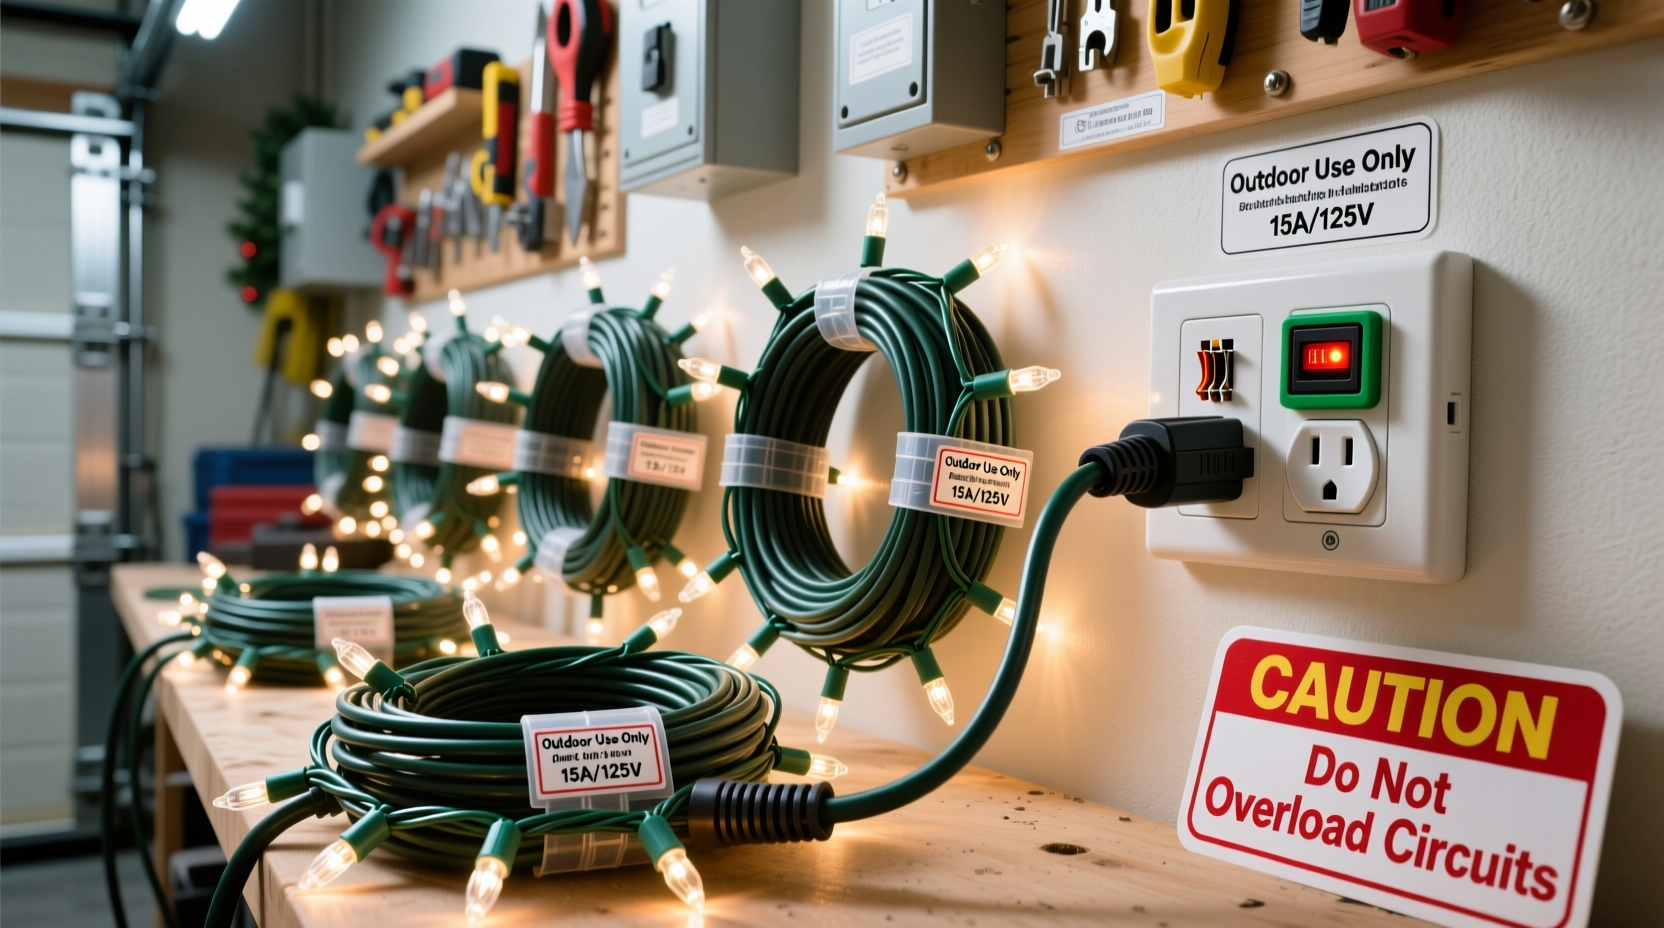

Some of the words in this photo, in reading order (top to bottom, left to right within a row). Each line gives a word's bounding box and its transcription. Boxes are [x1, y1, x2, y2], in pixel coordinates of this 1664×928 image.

[1230, 165, 1310, 194] Outdoor
[1315, 157, 1356, 180] Use
[1361, 143, 1416, 173] Only
[1269, 202, 1375, 237] 15A/125V
[952, 485, 1010, 506] 15A/125V
[1249, 653, 1559, 761] CAUTION
[542, 735, 593, 750] Outdoor
[621, 731, 650, 746] Only
[561, 762, 642, 783] 15A/125V
[1303, 743, 1360, 794] Do
[1371, 756, 1453, 815] Not
[1204, 775, 1375, 854] Overload
[1383, 816, 1558, 902] Circuits
